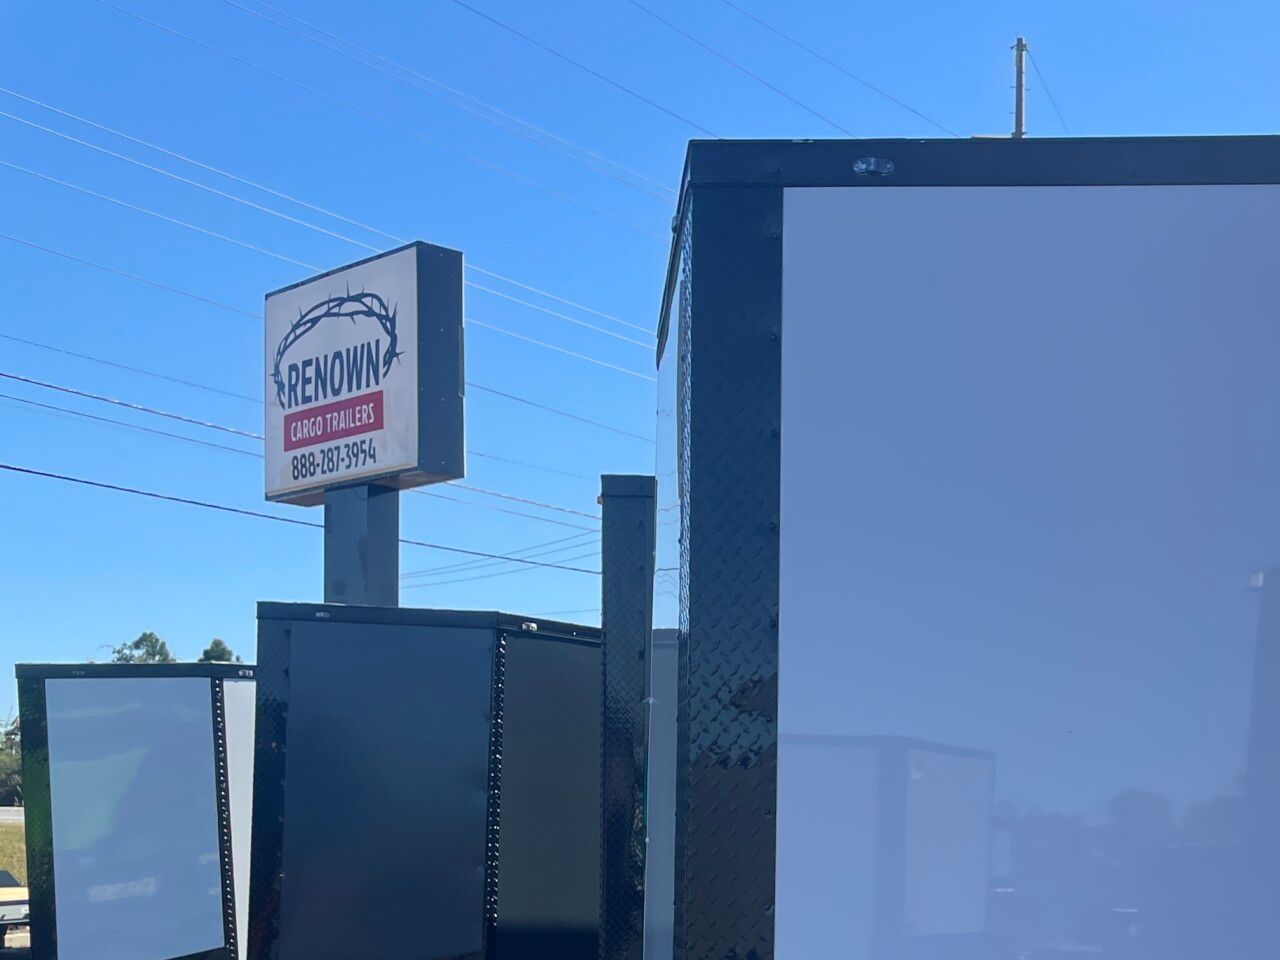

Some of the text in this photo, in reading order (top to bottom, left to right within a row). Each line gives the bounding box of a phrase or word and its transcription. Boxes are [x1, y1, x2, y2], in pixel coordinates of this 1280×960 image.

[287, 338, 381, 409] RENOWN
[290, 402, 375, 442] CARGO TRAILERS
[291, 438, 377, 481] 888-287-3954
